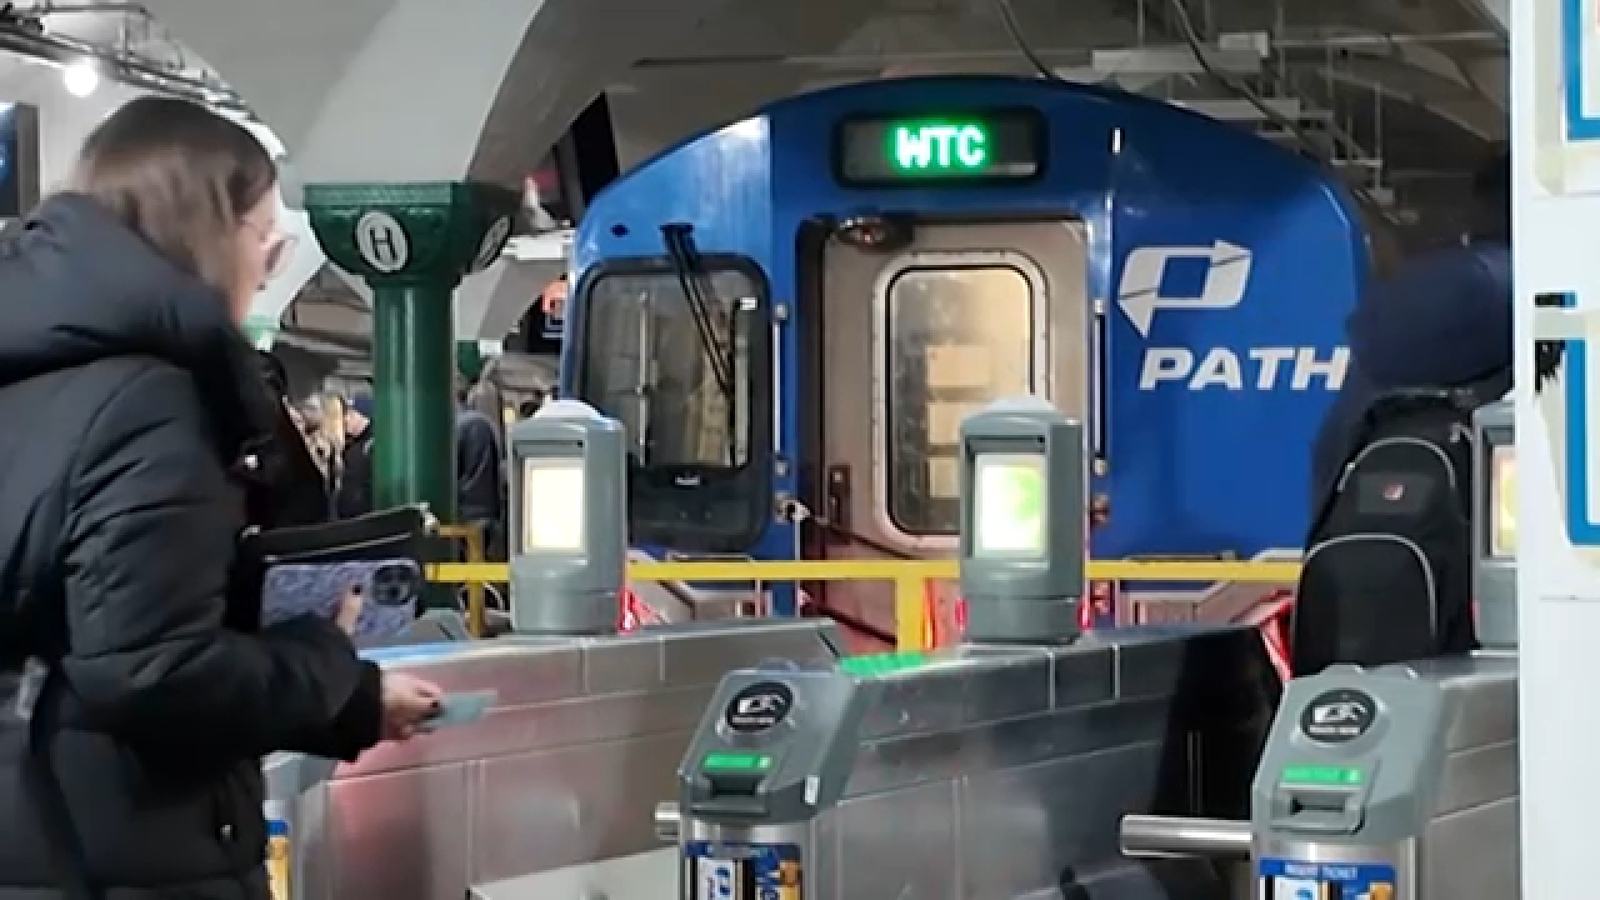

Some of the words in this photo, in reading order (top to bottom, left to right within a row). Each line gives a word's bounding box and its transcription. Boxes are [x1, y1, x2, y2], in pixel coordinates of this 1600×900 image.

[894, 125, 986, 168] WTC
[369, 226, 399, 262] H
[1139, 346, 1351, 391] PATH
